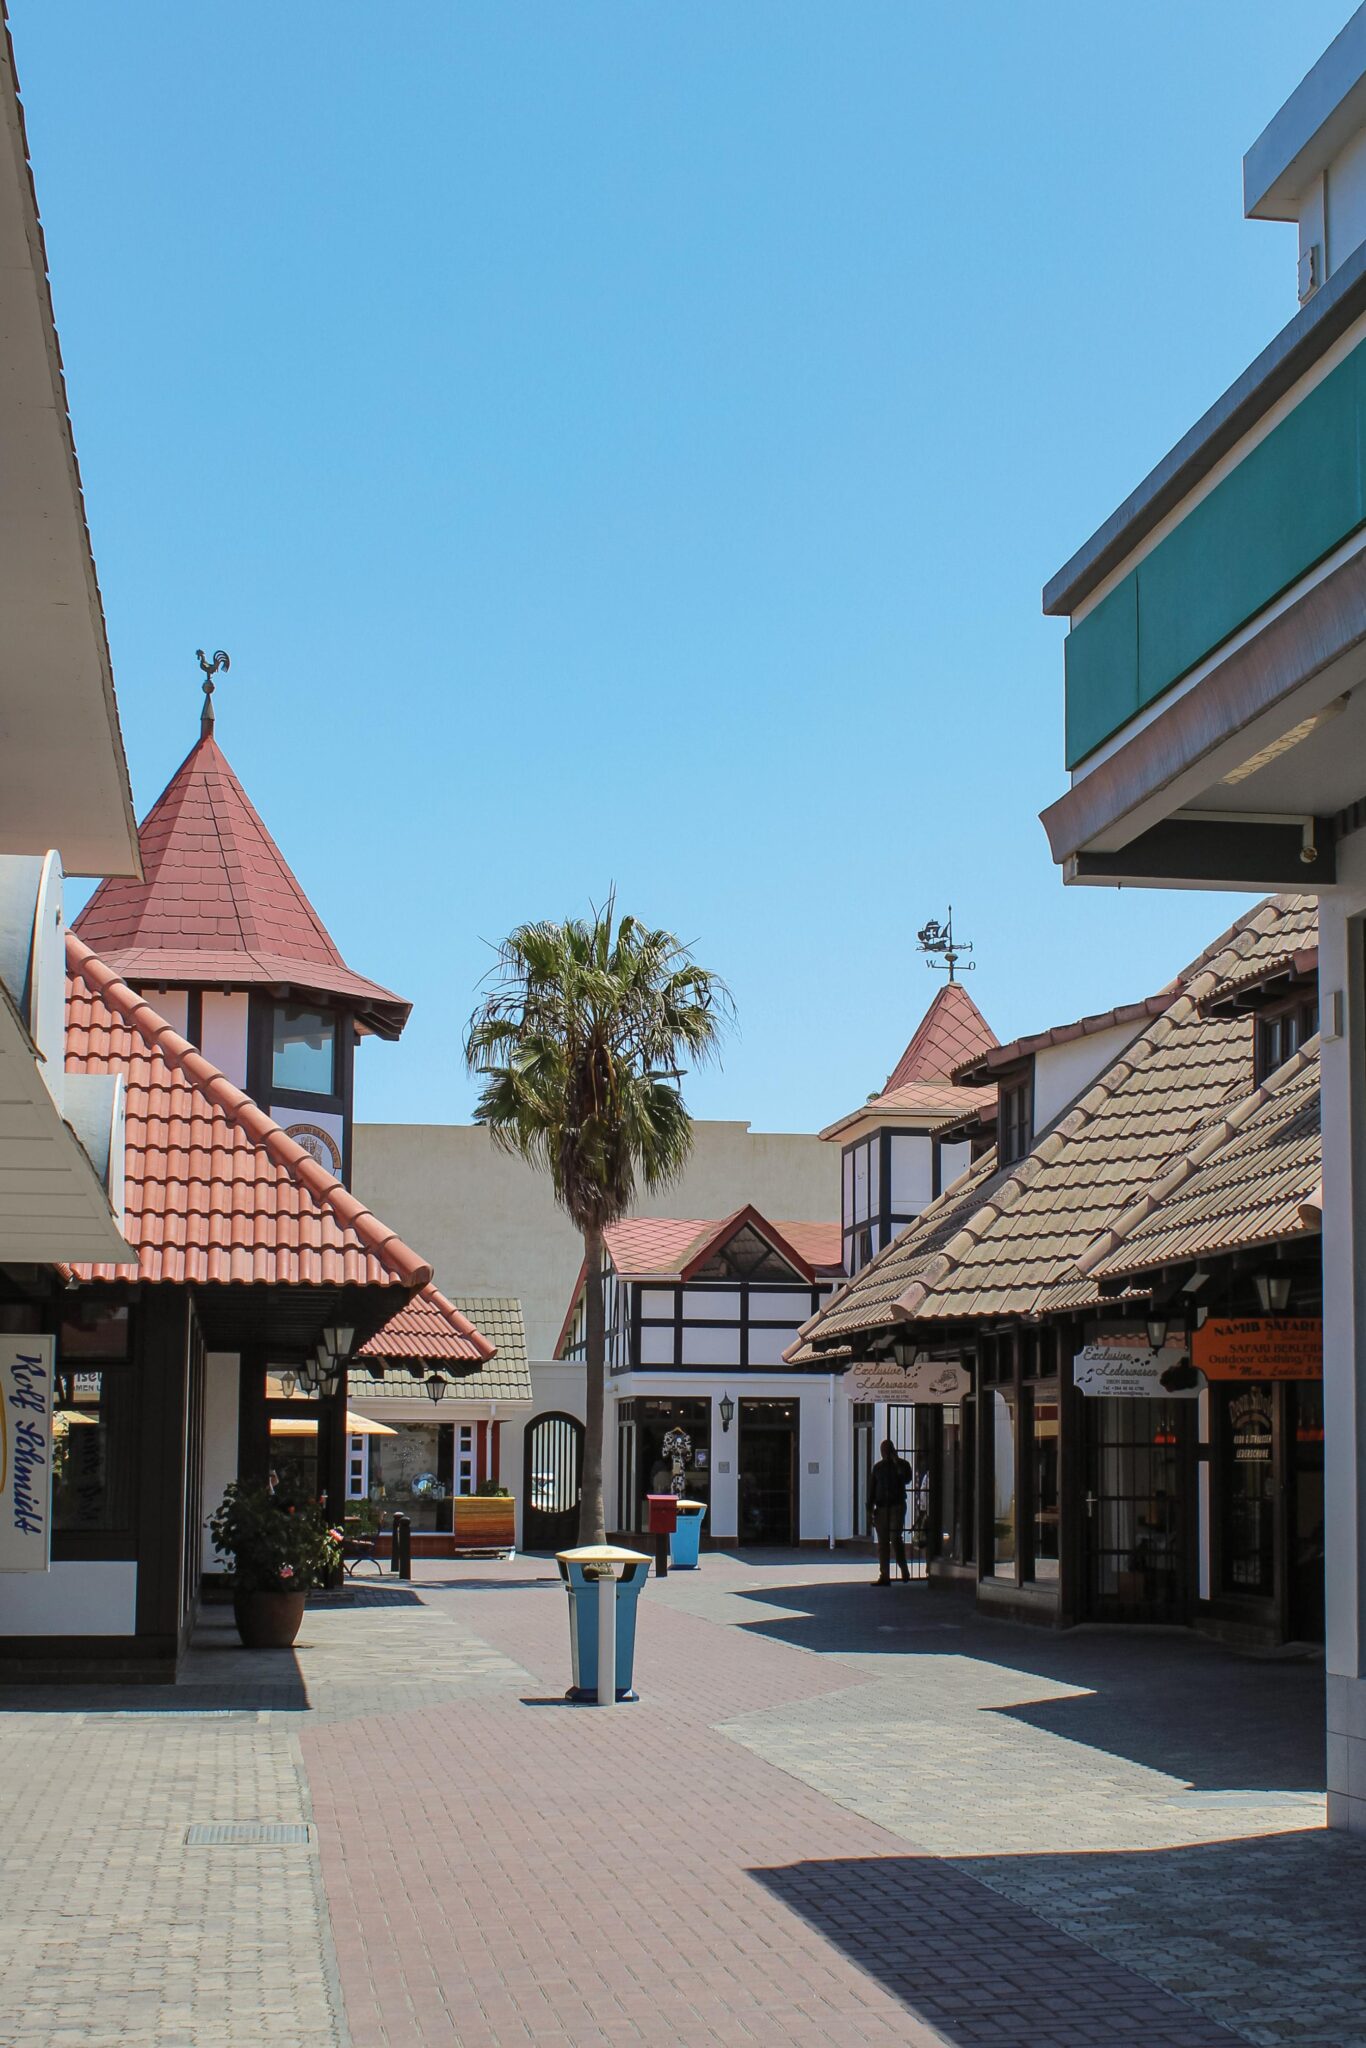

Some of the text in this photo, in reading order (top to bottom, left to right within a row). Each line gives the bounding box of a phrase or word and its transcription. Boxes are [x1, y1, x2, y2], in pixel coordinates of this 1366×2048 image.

[1214, 1321, 1261, 1336] NAMIB
[1265, 1319, 1315, 1332] SAFARI
[1083, 1346, 1133, 1361] Exclusive
[1229, 1343, 1270, 1353] SAFARI
[1209, 1354, 1254, 1363] Outdoor
[853, 1363, 904, 1376] Exclusive
[1095, 1362, 1159, 1377] Lederwaren
[856, 1376, 920, 1389] Lederwaren
[9, 1353, 47, 1536] Rolf Schmidt
